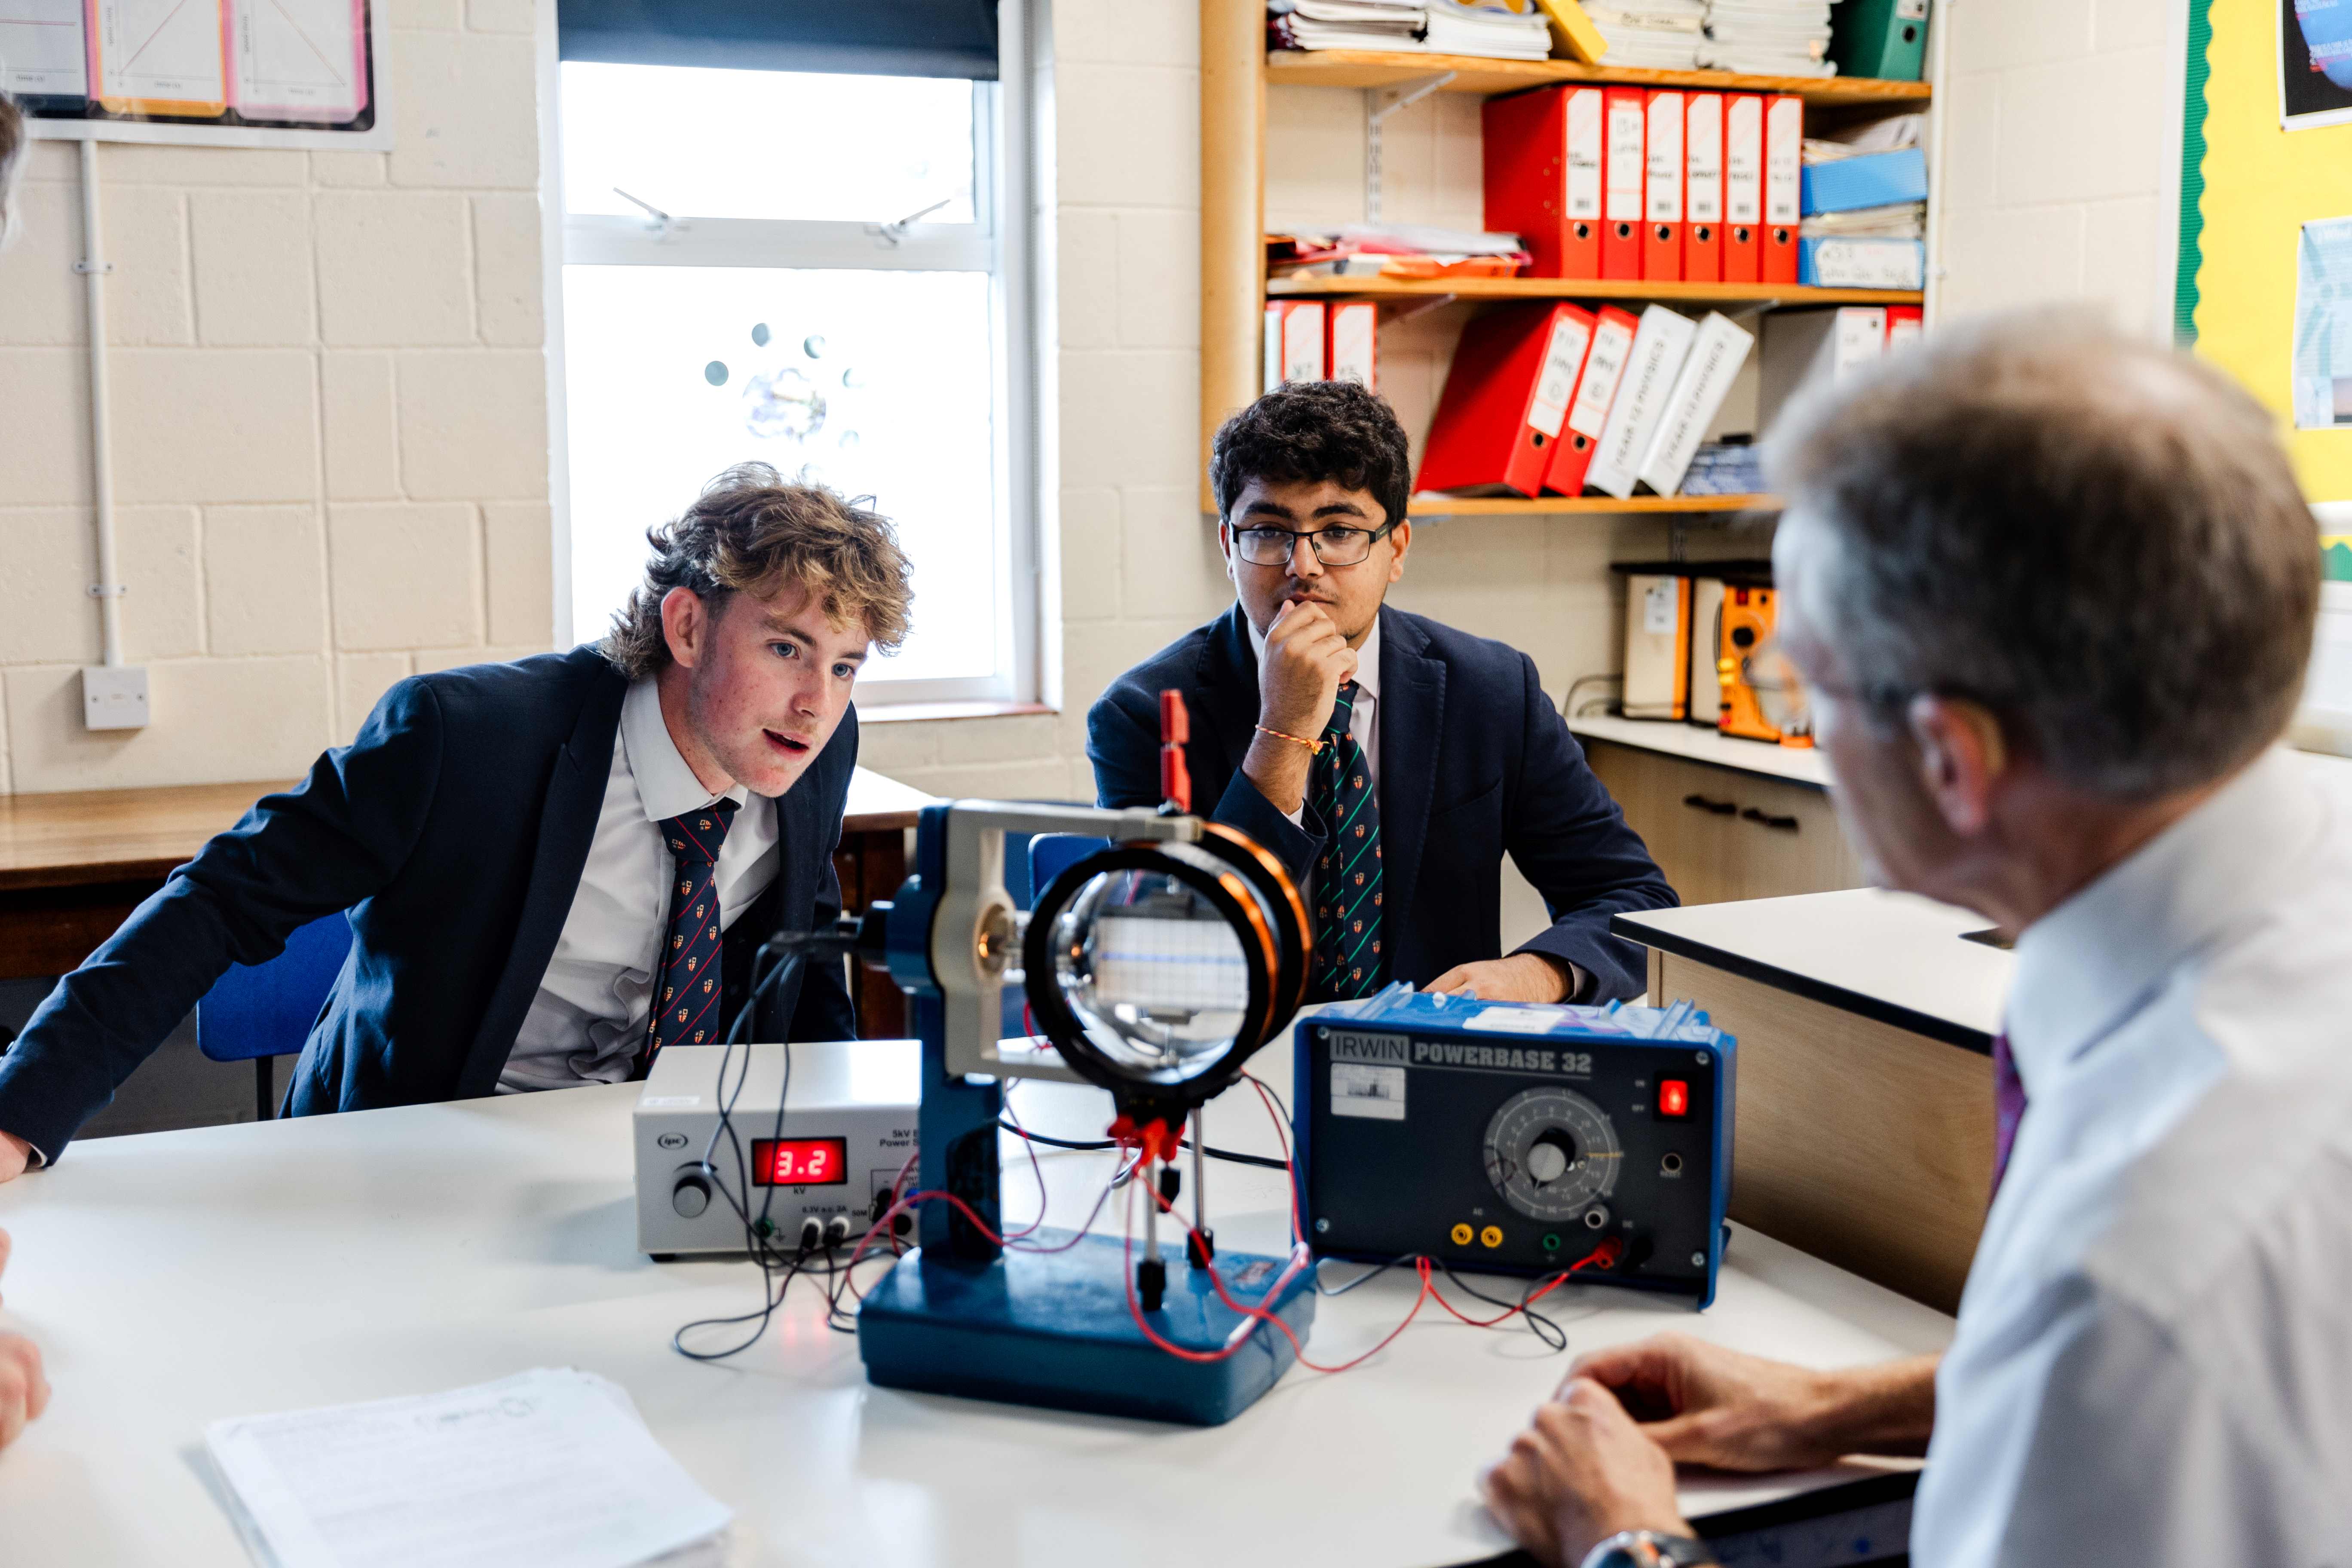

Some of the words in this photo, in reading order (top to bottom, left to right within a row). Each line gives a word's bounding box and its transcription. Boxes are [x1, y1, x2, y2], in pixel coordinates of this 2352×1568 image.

[1336, 1036, 1404, 1060] IRWIN
[1415, 1042, 1555, 1070] POWERBASE
[1562, 1053, 1591, 1073] 32
[892, 1129, 910, 1138] 5kV
[777, 1150, 827, 1177] 3.2
[793, 1186, 806, 1194] kV
